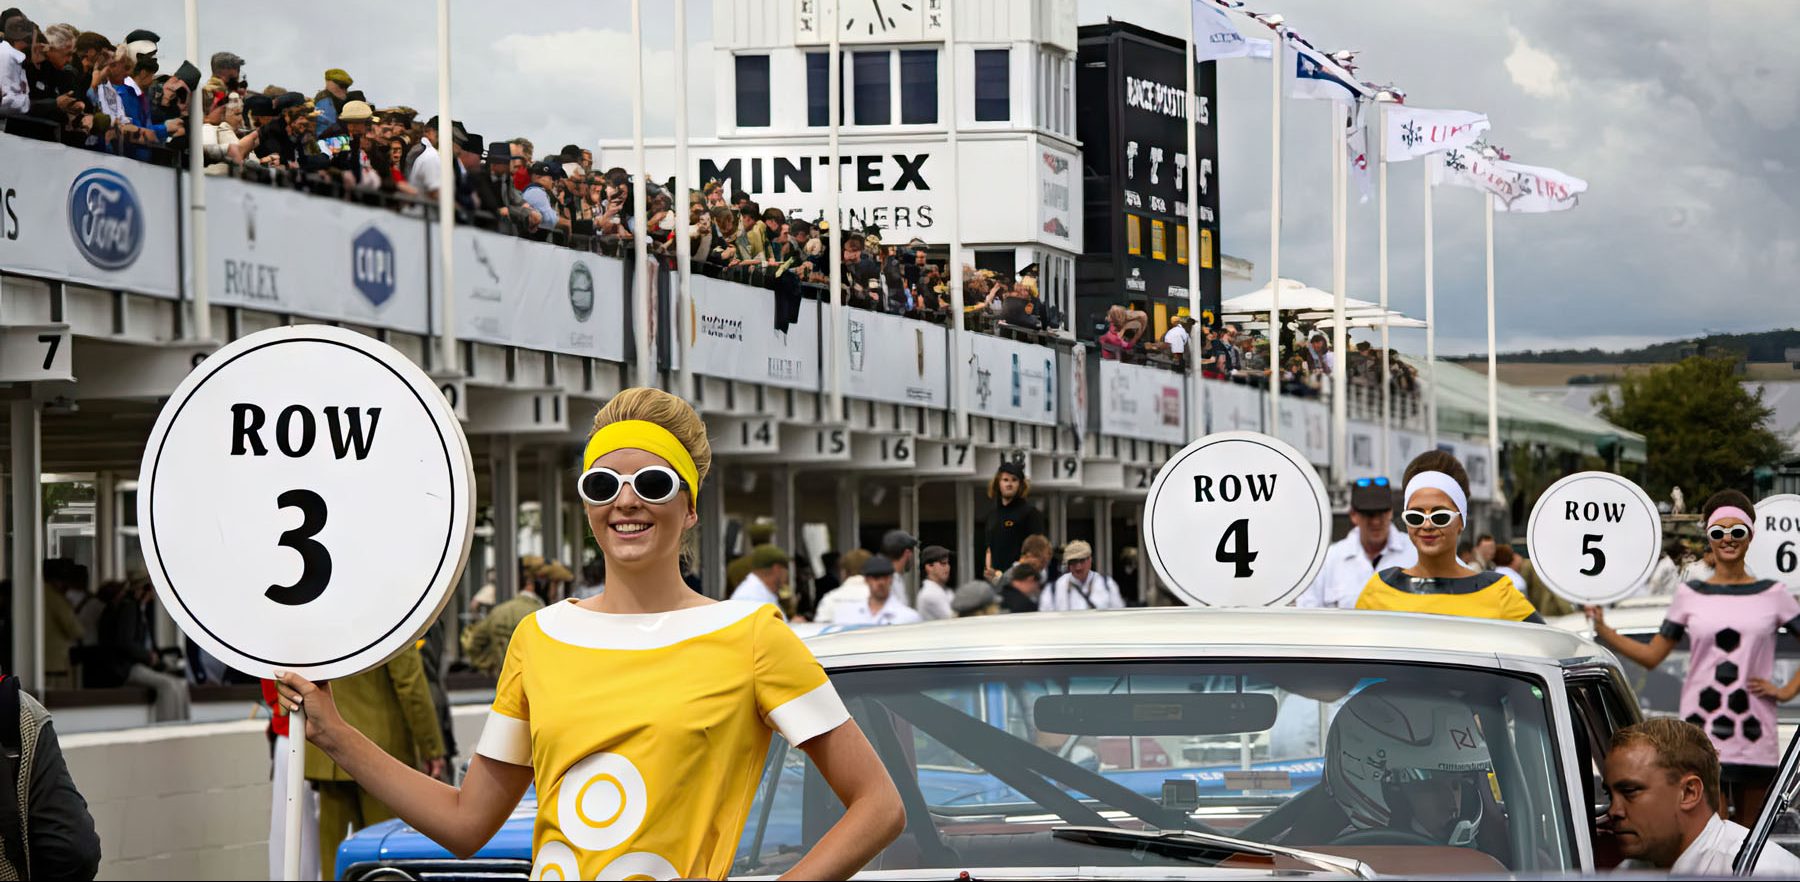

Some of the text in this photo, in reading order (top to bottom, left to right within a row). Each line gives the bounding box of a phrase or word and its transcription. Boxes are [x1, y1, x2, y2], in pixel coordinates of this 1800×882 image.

[0, 186, 20, 240] S
[81, 181, 135, 254] Ford
[819, 205, 934, 231] NERS
[224, 259, 280, 301] ROLEX
[38, 334, 62, 370] 7
[534, 394, 560, 423] 11
[231, 403, 381, 460] ROW
[742, 420, 770, 447] 14
[817, 430, 845, 454] 15
[881, 436, 911, 461] 16
[942, 445, 969, 466] 17
[1052, 456, 1078, 479] 19
[1194, 474, 1277, 502] ROW
[1565, 501, 1626, 523] ROW
[265, 489, 332, 605] 3
[1216, 518, 1258, 578] 4
[1580, 534, 1605, 576] 5
[1776, 541, 1797, 573] 6
